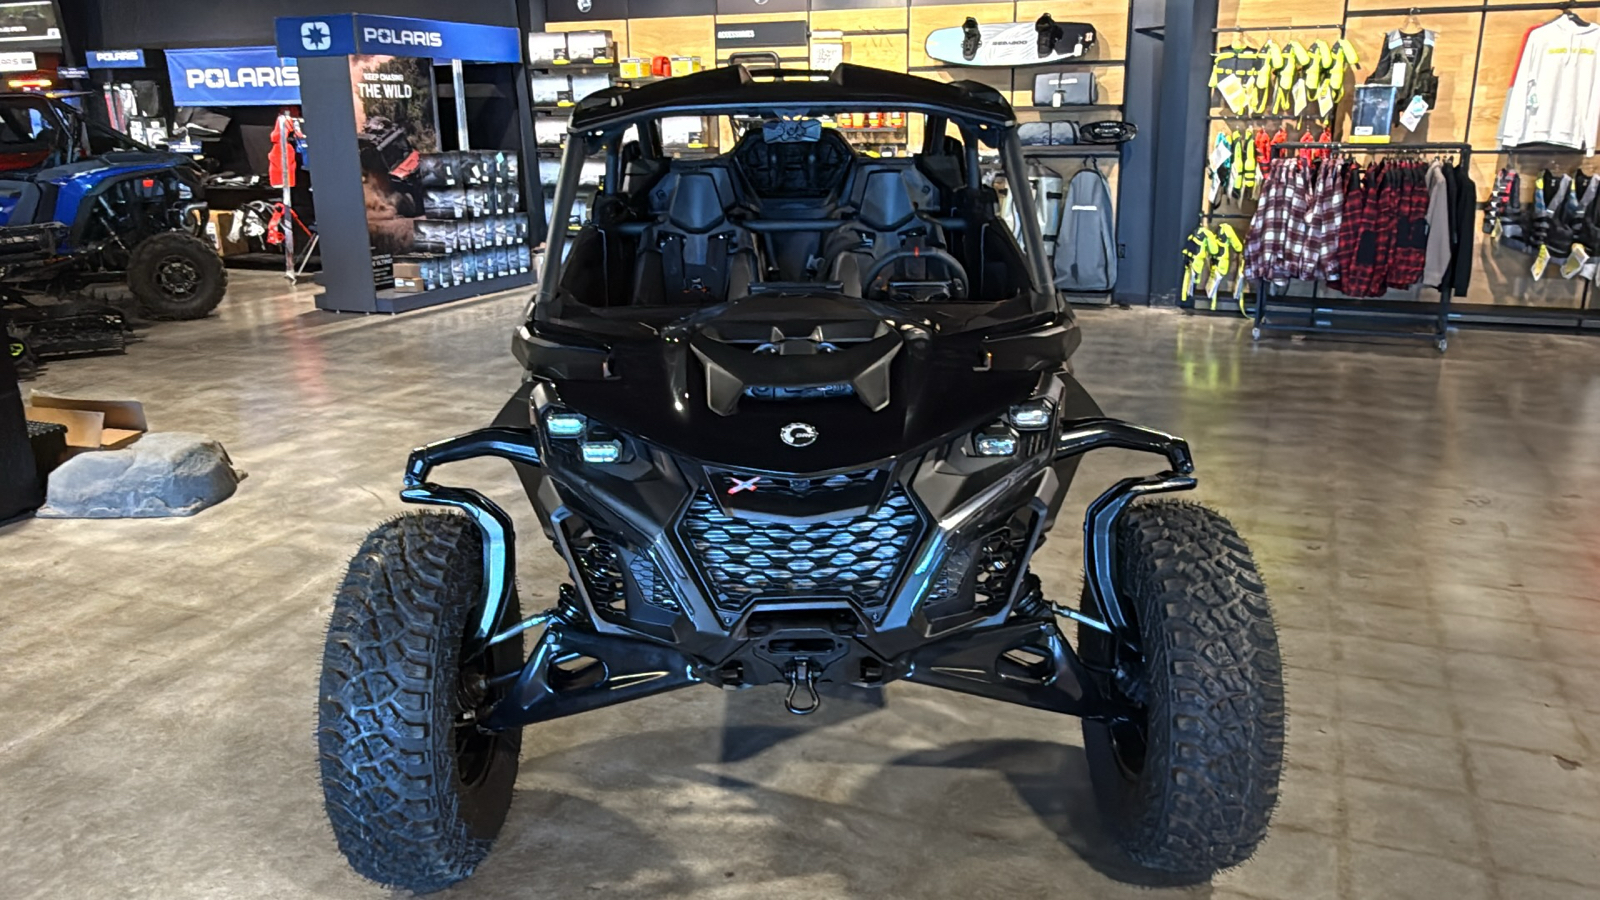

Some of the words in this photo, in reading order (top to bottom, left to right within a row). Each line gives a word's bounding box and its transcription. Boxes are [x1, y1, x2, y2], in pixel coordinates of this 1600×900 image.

[364, 28, 442, 48] POLARIS
[186, 66, 300, 89] POLARIS
[363, 72, 379, 81] KEEP
[380, 73, 404, 82] CHASING
[357, 83, 383, 98] THE
[384, 83, 412, 99] WILD
